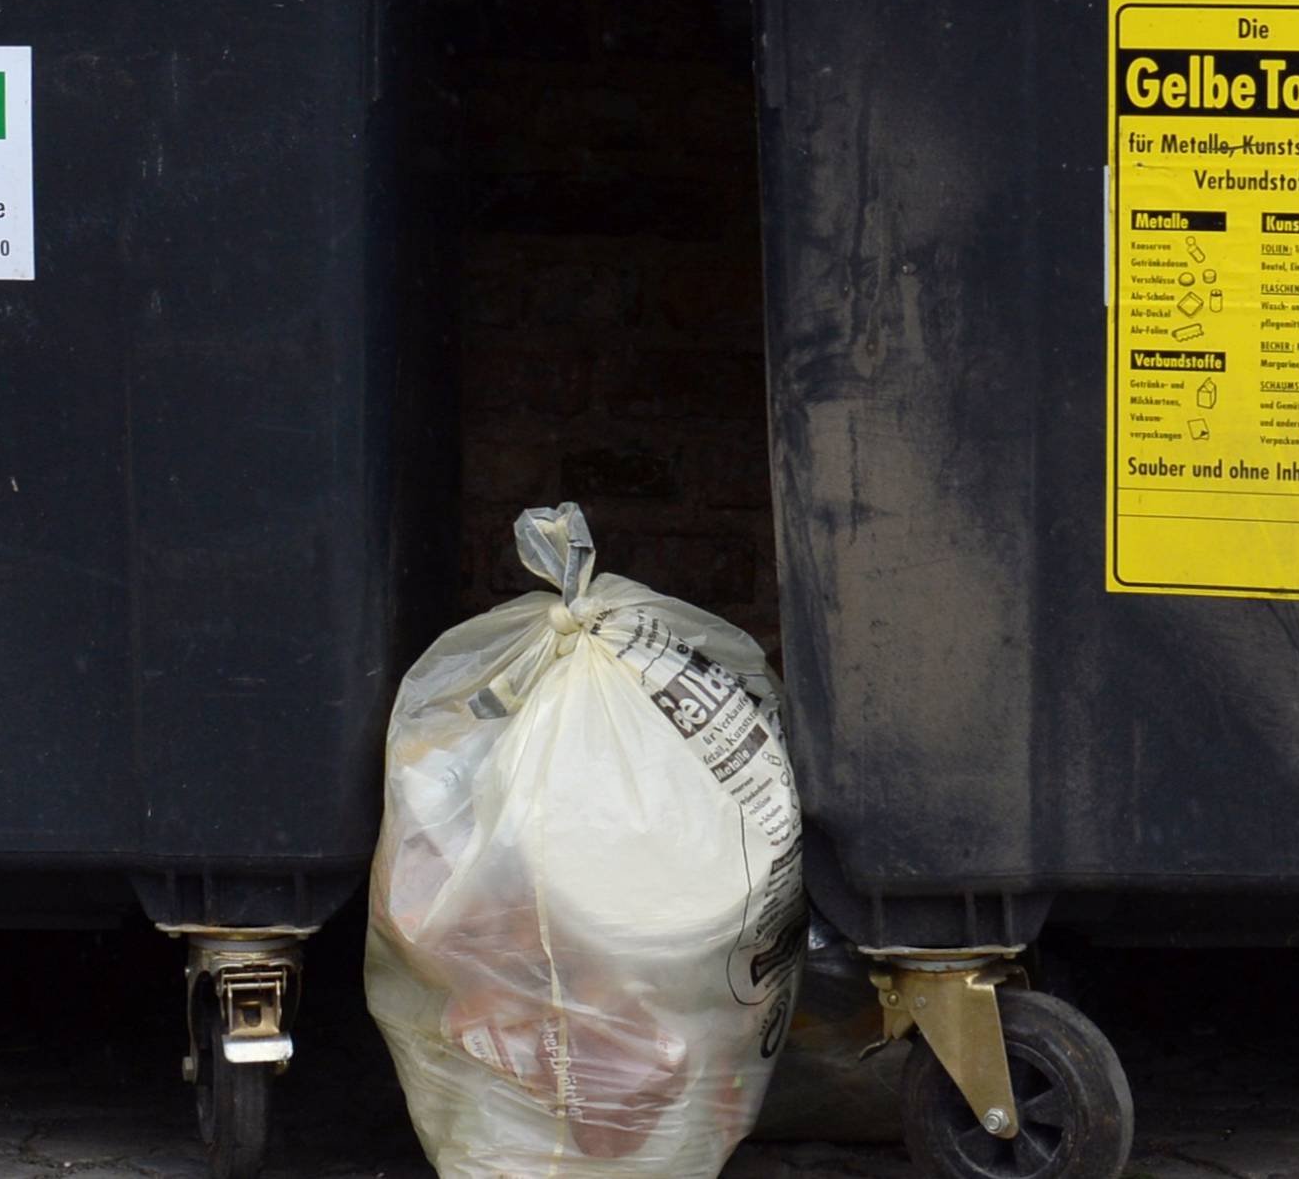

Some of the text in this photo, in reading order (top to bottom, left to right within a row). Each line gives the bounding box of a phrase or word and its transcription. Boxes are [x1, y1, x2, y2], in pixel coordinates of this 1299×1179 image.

[1238, 18, 1269, 39] Die
[1126, 55, 1256, 110] Gelbe
[1129, 132, 1154, 153] für
[1161, 133, 1235, 158] Metalle,
[1135, 212, 1189, 229] Metalle
[1134, 353, 1222, 369] Verbundstoffe
[1128, 456, 1186, 477] Sauber
[1192, 458, 1222, 478] und
[1229, 459, 1269, 480] ohne
